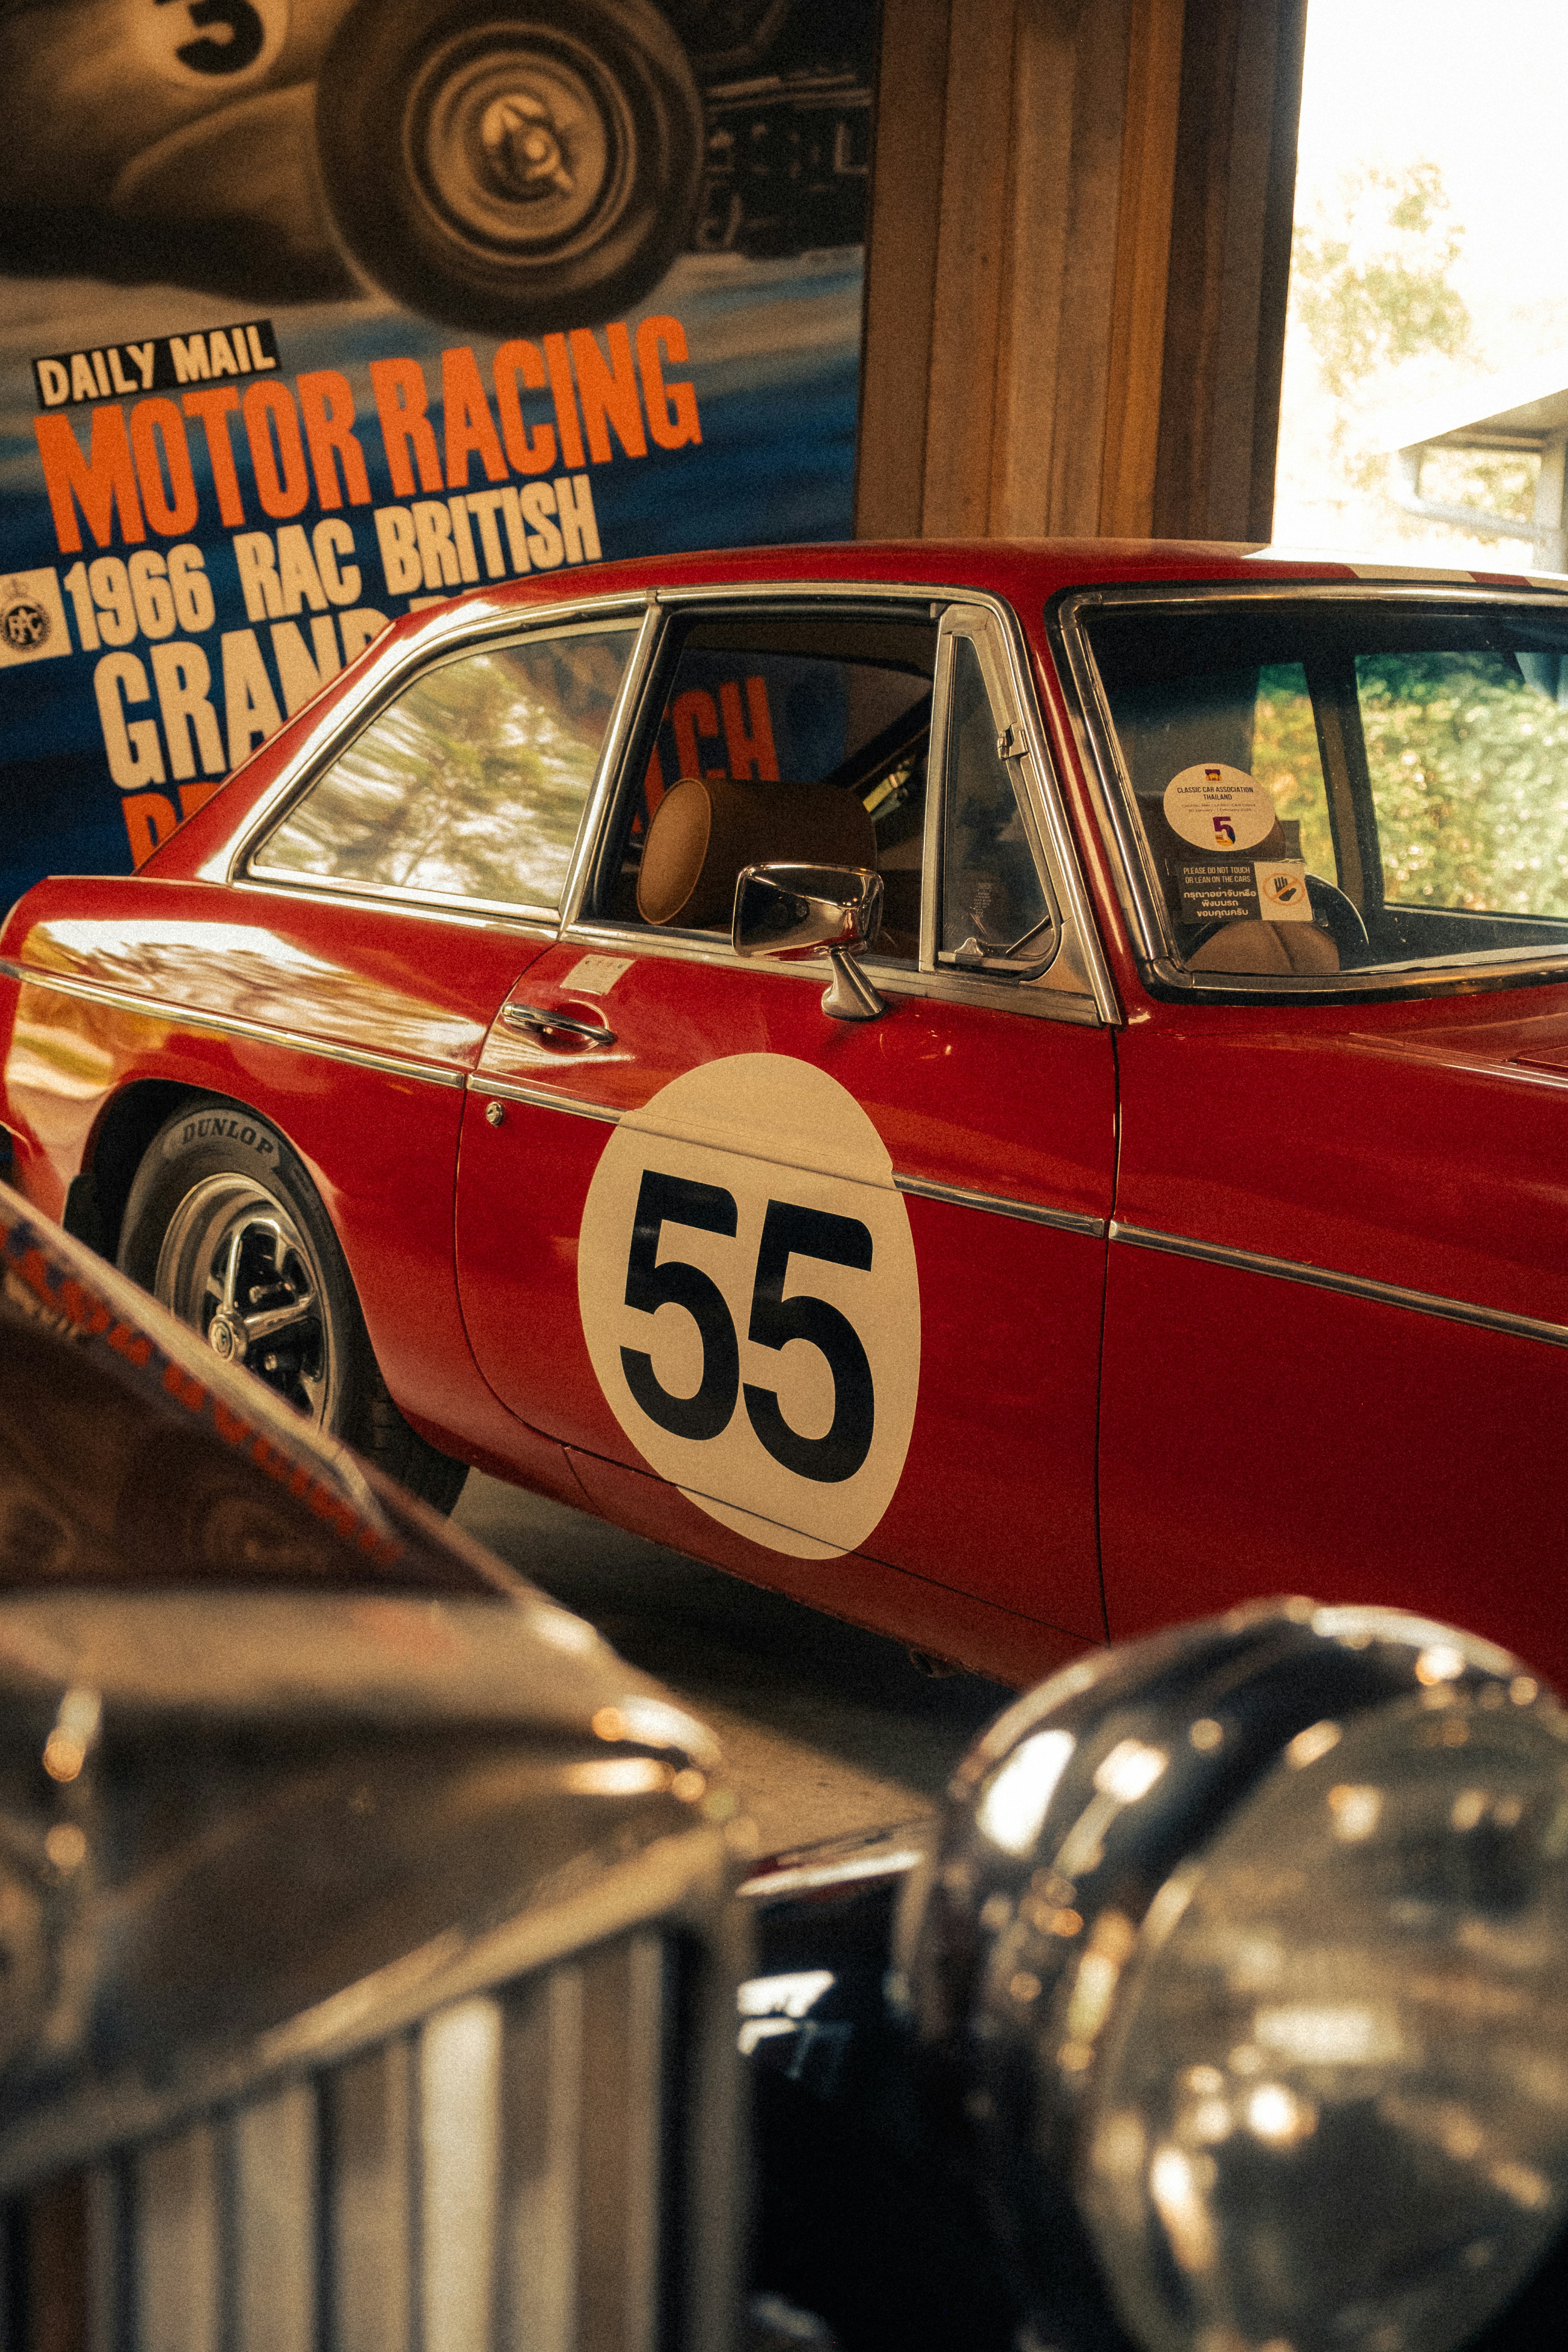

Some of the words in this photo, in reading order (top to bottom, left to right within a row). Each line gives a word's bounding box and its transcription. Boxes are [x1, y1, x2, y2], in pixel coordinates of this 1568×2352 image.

[37, 341, 155, 407] DAILY
[168, 325, 277, 384] MAIL
[32, 368, 372, 553] MOTOR
[368, 313, 703, 498] RACING
[63, 543, 215, 652] 1966
[233, 518, 362, 622] RAC
[374, 474, 602, 596] BRITISH
[1213, 816, 1236, 846] 5
[1196, 908, 1248, 918] ขอบคุณครับ
[182, 1118, 274, 1154] DUNLOP
[619, 1169, 875, 1483] 55
